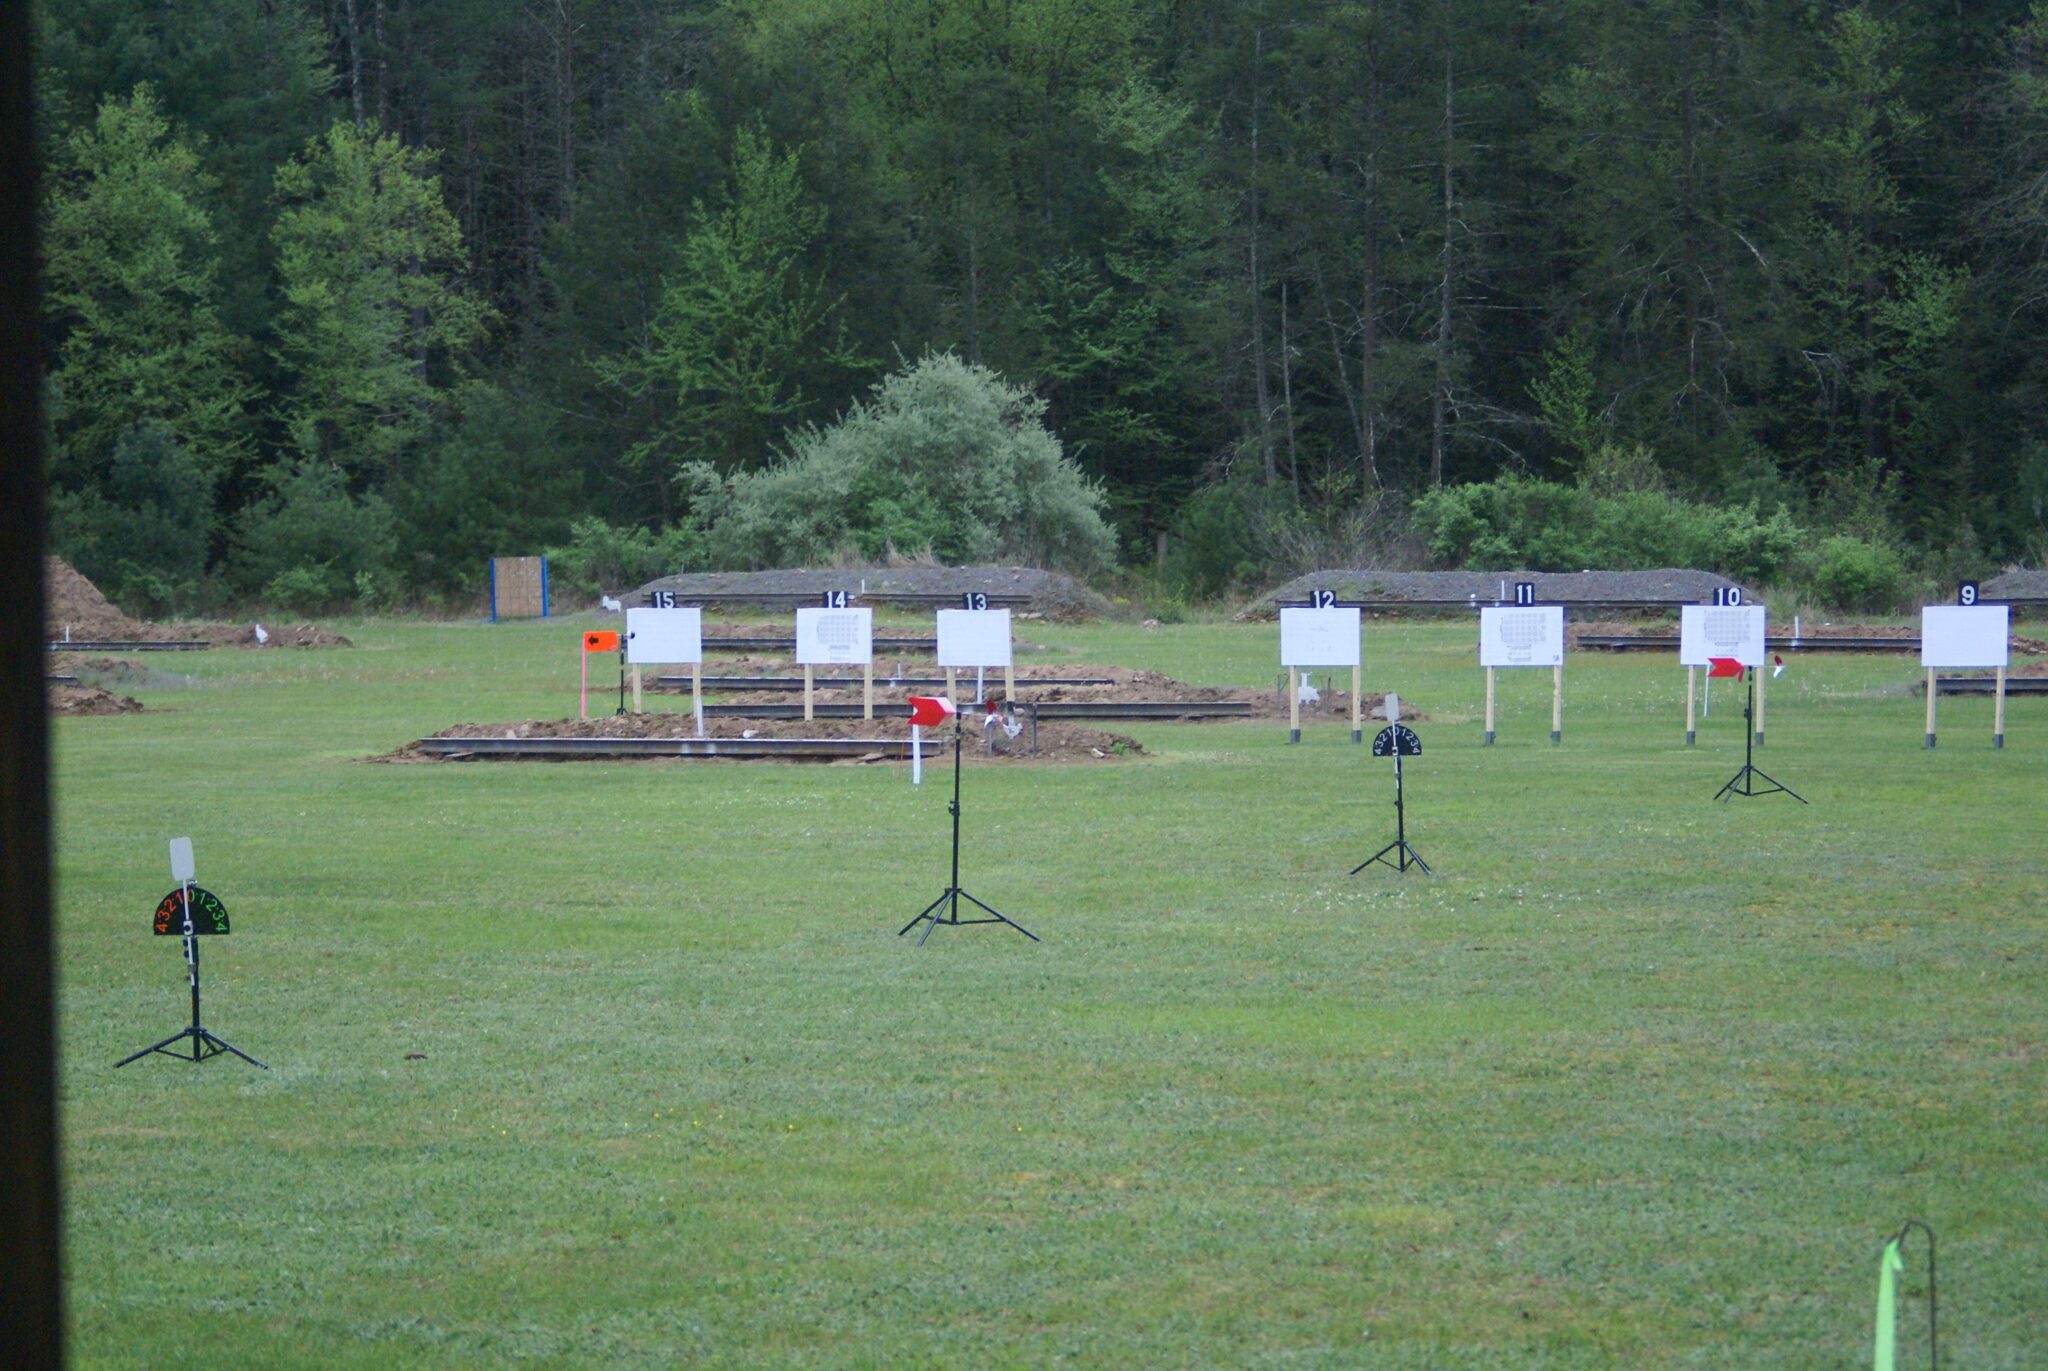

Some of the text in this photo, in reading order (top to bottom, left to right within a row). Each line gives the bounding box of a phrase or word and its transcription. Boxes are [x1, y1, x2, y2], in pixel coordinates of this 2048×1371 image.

[655, 591, 674, 608] 15
[827, 590, 846, 608] 14
[1313, 590, 1335, 608] 12
[1516, 584, 1532, 604] 11
[1718, 587, 1741, 606] 10
[1961, 585, 1975, 605] 9
[966, 592, 987, 610] 13
[1379, 733, 1388, 742] 2
[1386, 728, 1392, 736] 1
[1401, 728, 1407, 737] 1
[1405, 733, 1414, 741] 2
[1375, 740, 1384, 748] 3
[176, 892, 183, 904] 1
[200, 892, 206, 905] 1
[164, 899, 176, 912] 2
[206, 899, 218, 912] 2
[157, 910, 170, 921] 3
[212, 910, 225, 920] 3
[156, 923, 168, 933] 4
[216, 922, 228, 932] 4
